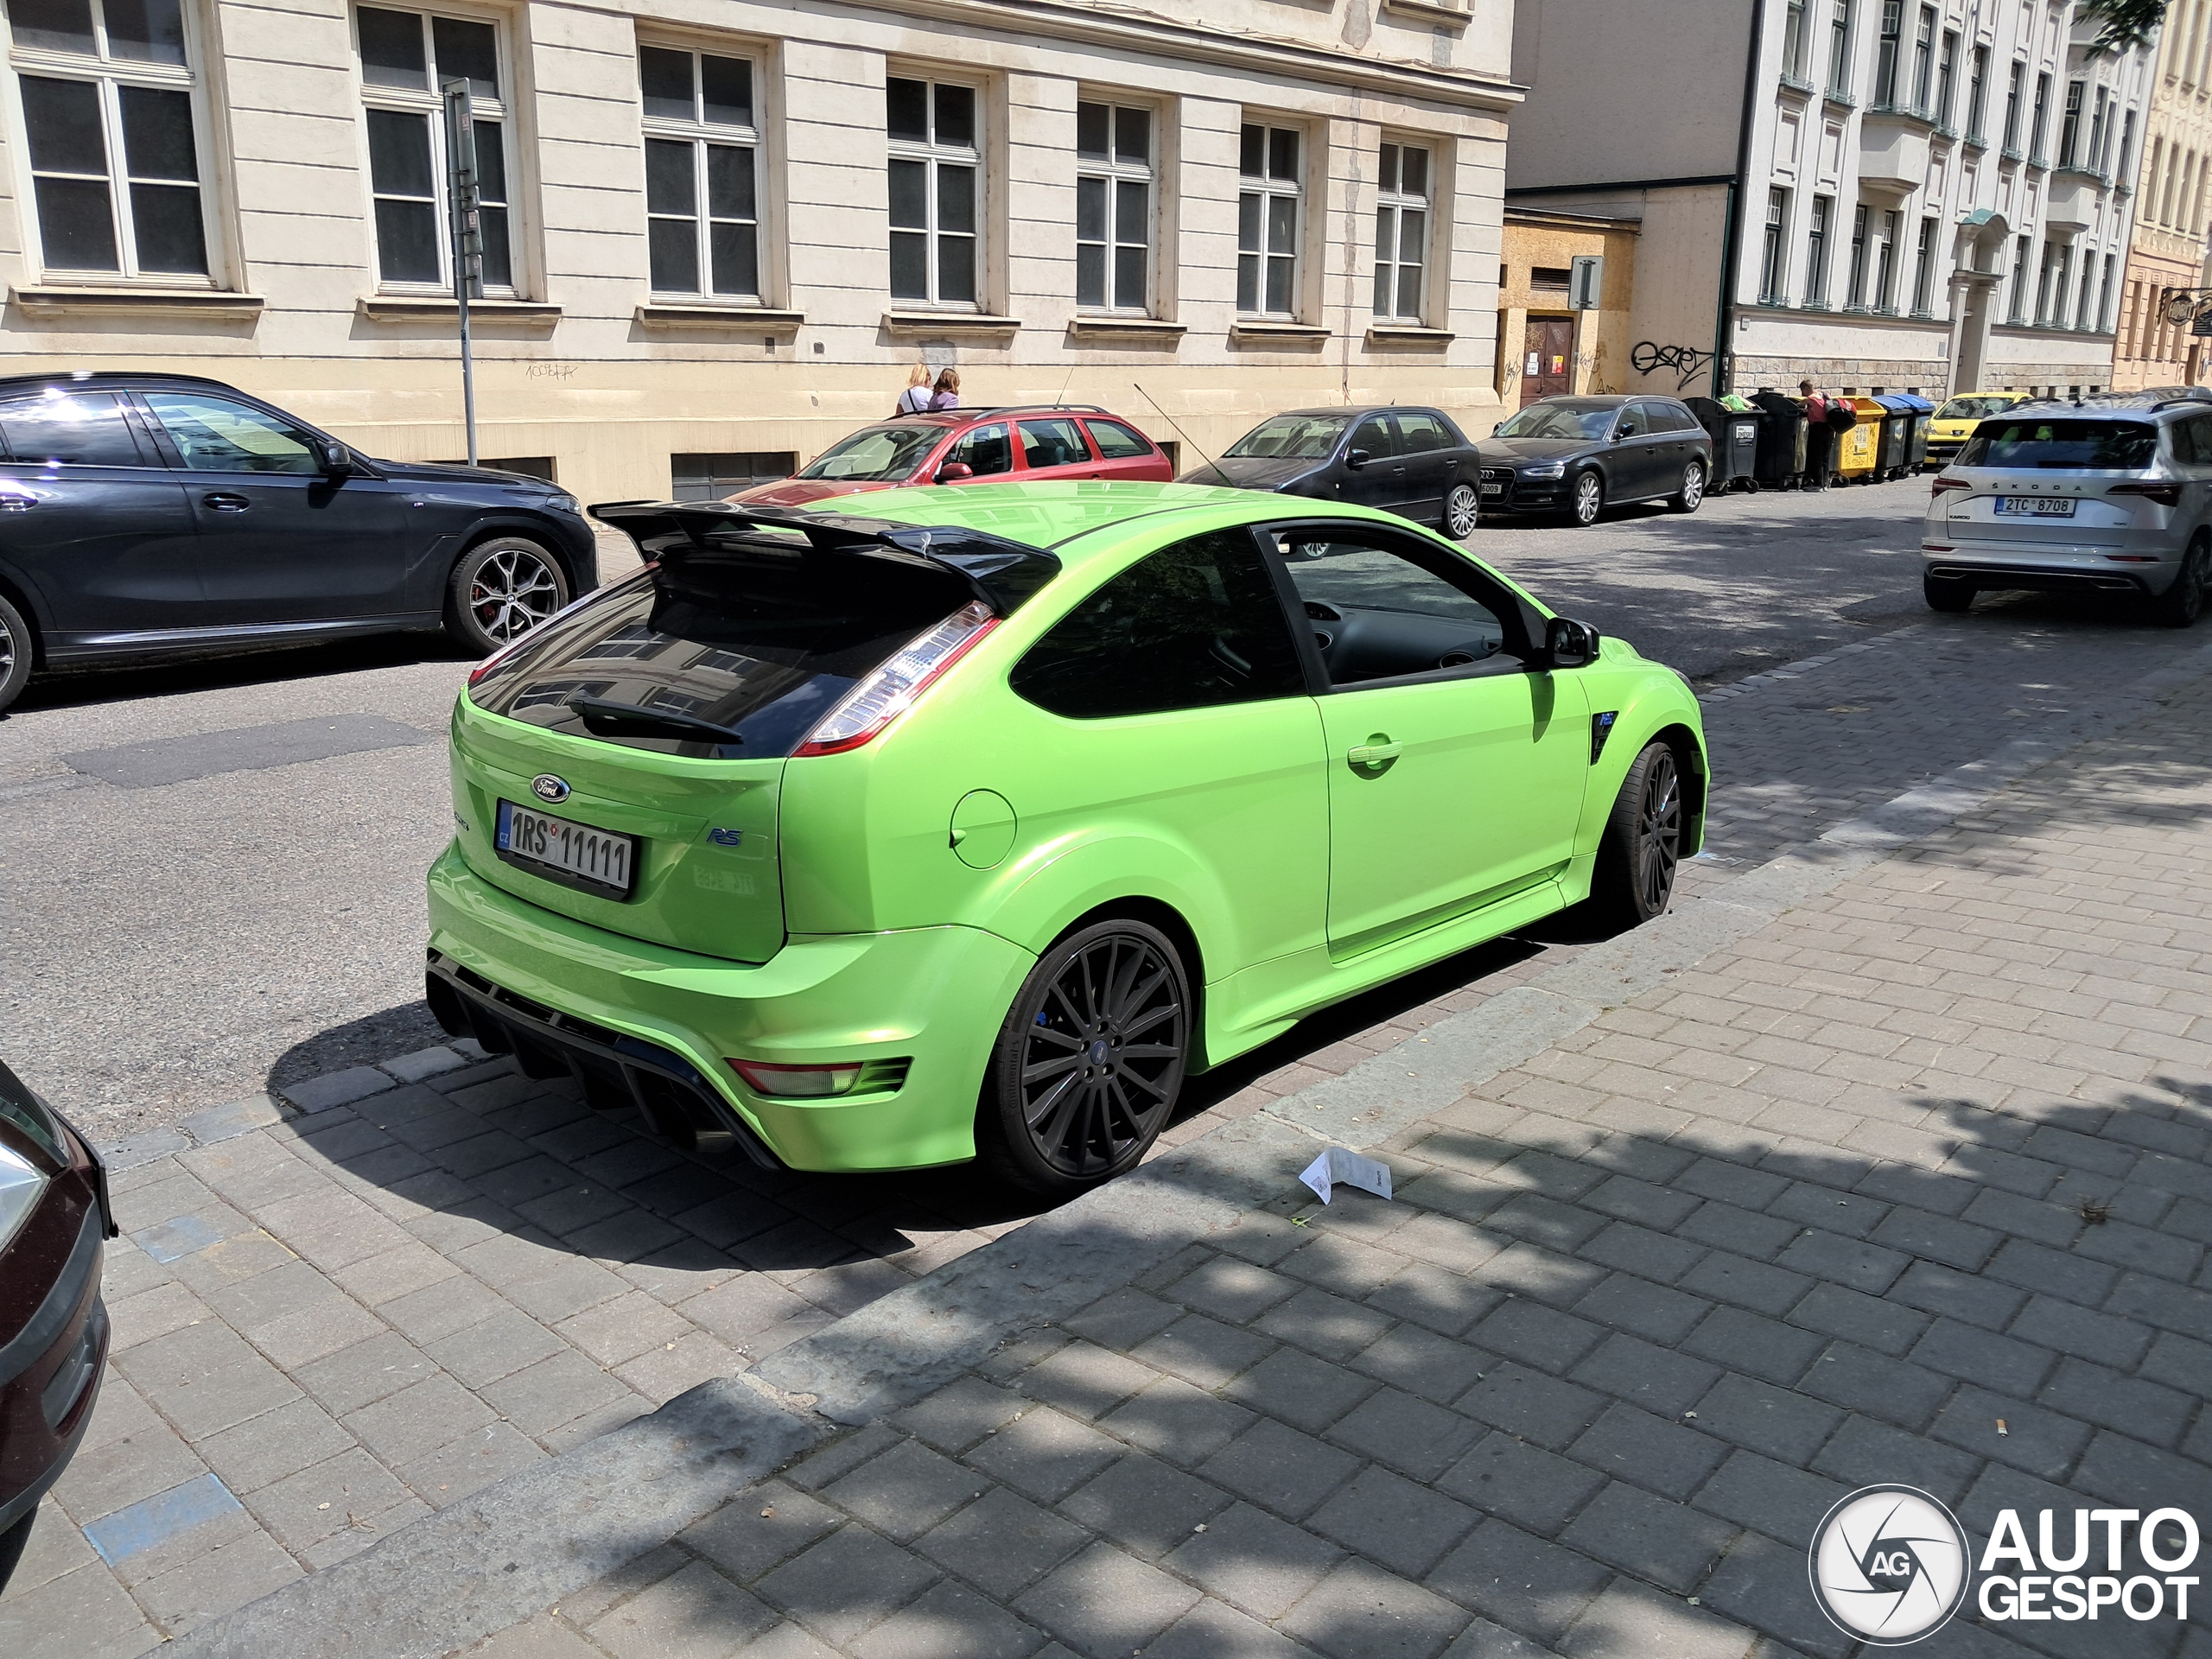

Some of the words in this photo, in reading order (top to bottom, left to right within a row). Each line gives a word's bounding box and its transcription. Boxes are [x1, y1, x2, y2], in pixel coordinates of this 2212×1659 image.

[2005, 499, 2030, 511] 2TC
[2037, 499, 2069, 512] 8708
[537, 779, 558, 797] Ford
[499, 832, 508, 844] CZ
[706, 827, 743, 847] RS
[512, 812, 548, 855] 1RS
[561, 826, 626, 881] 11111
